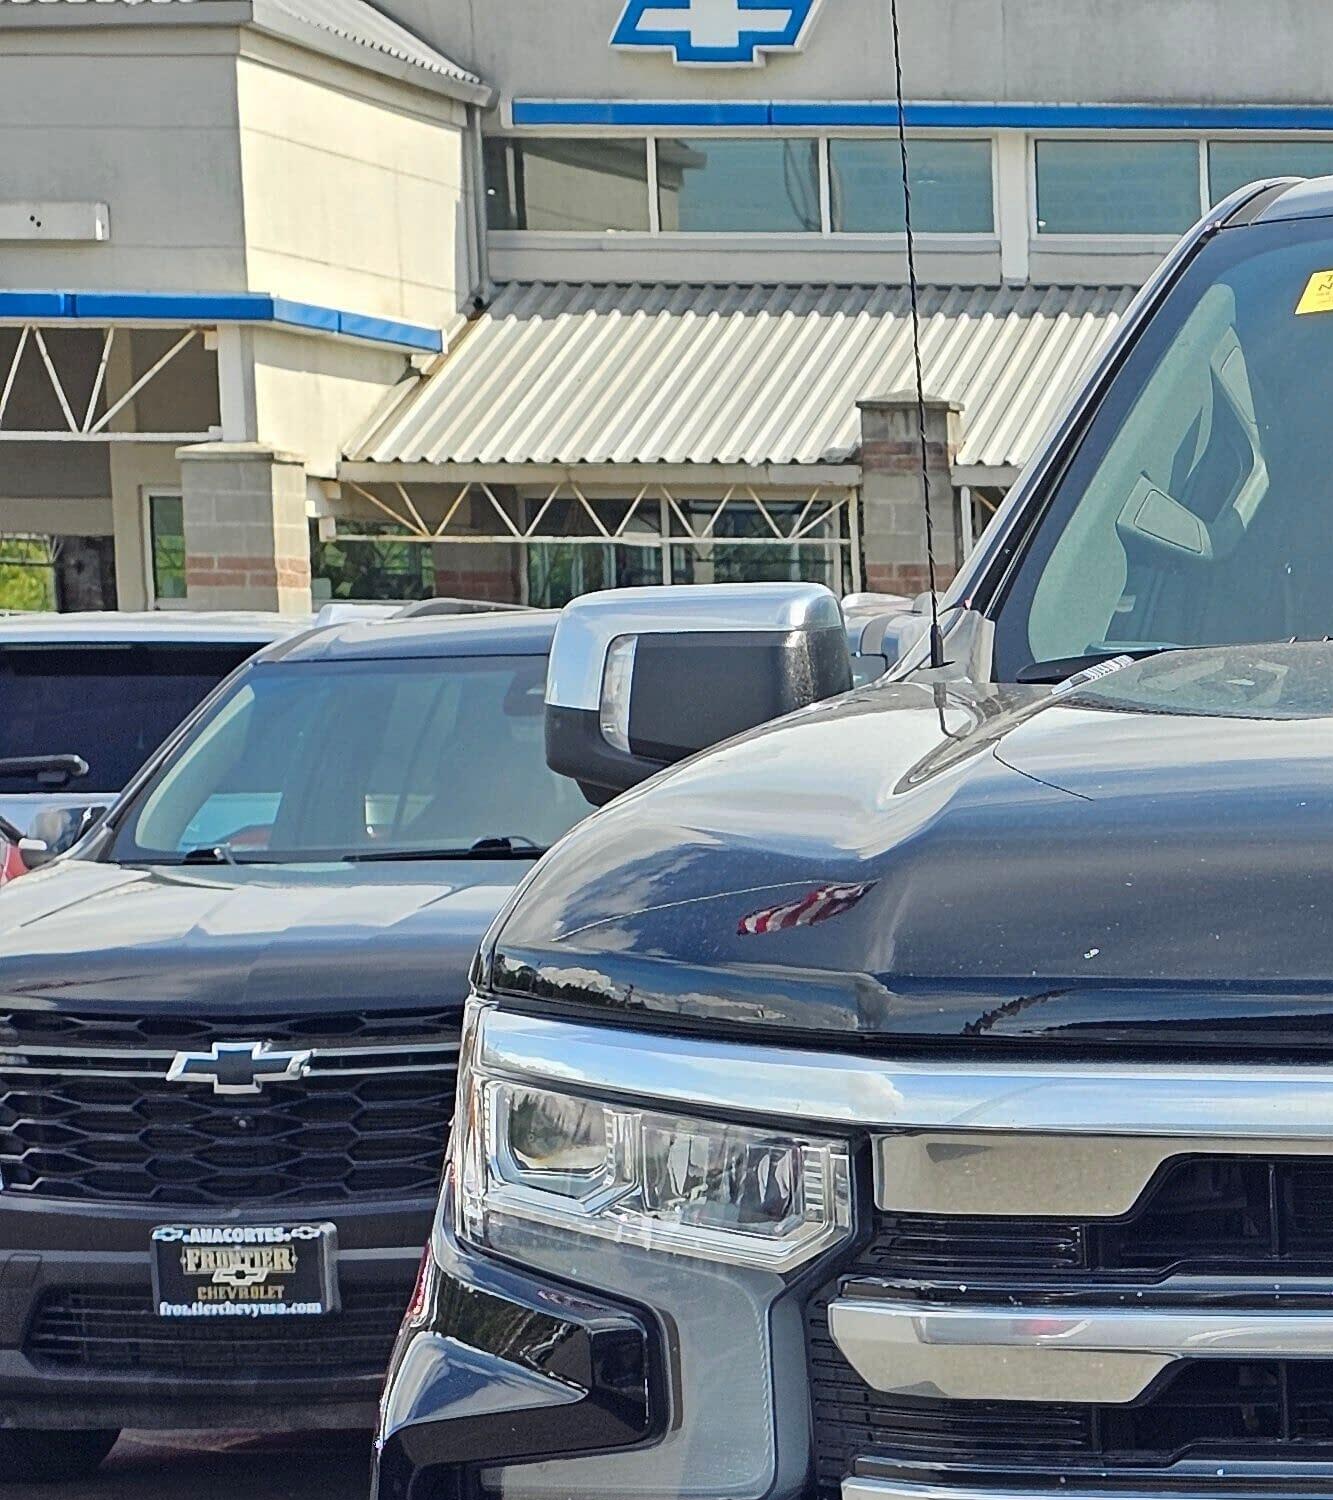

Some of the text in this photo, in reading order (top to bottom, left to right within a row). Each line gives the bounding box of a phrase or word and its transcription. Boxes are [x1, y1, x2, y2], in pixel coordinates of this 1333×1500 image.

[190, 1228, 284, 1243] ANACORTES
[186, 1248, 292, 1271] FRONTIER
[197, 1285, 285, 1299] CHEVROLET
